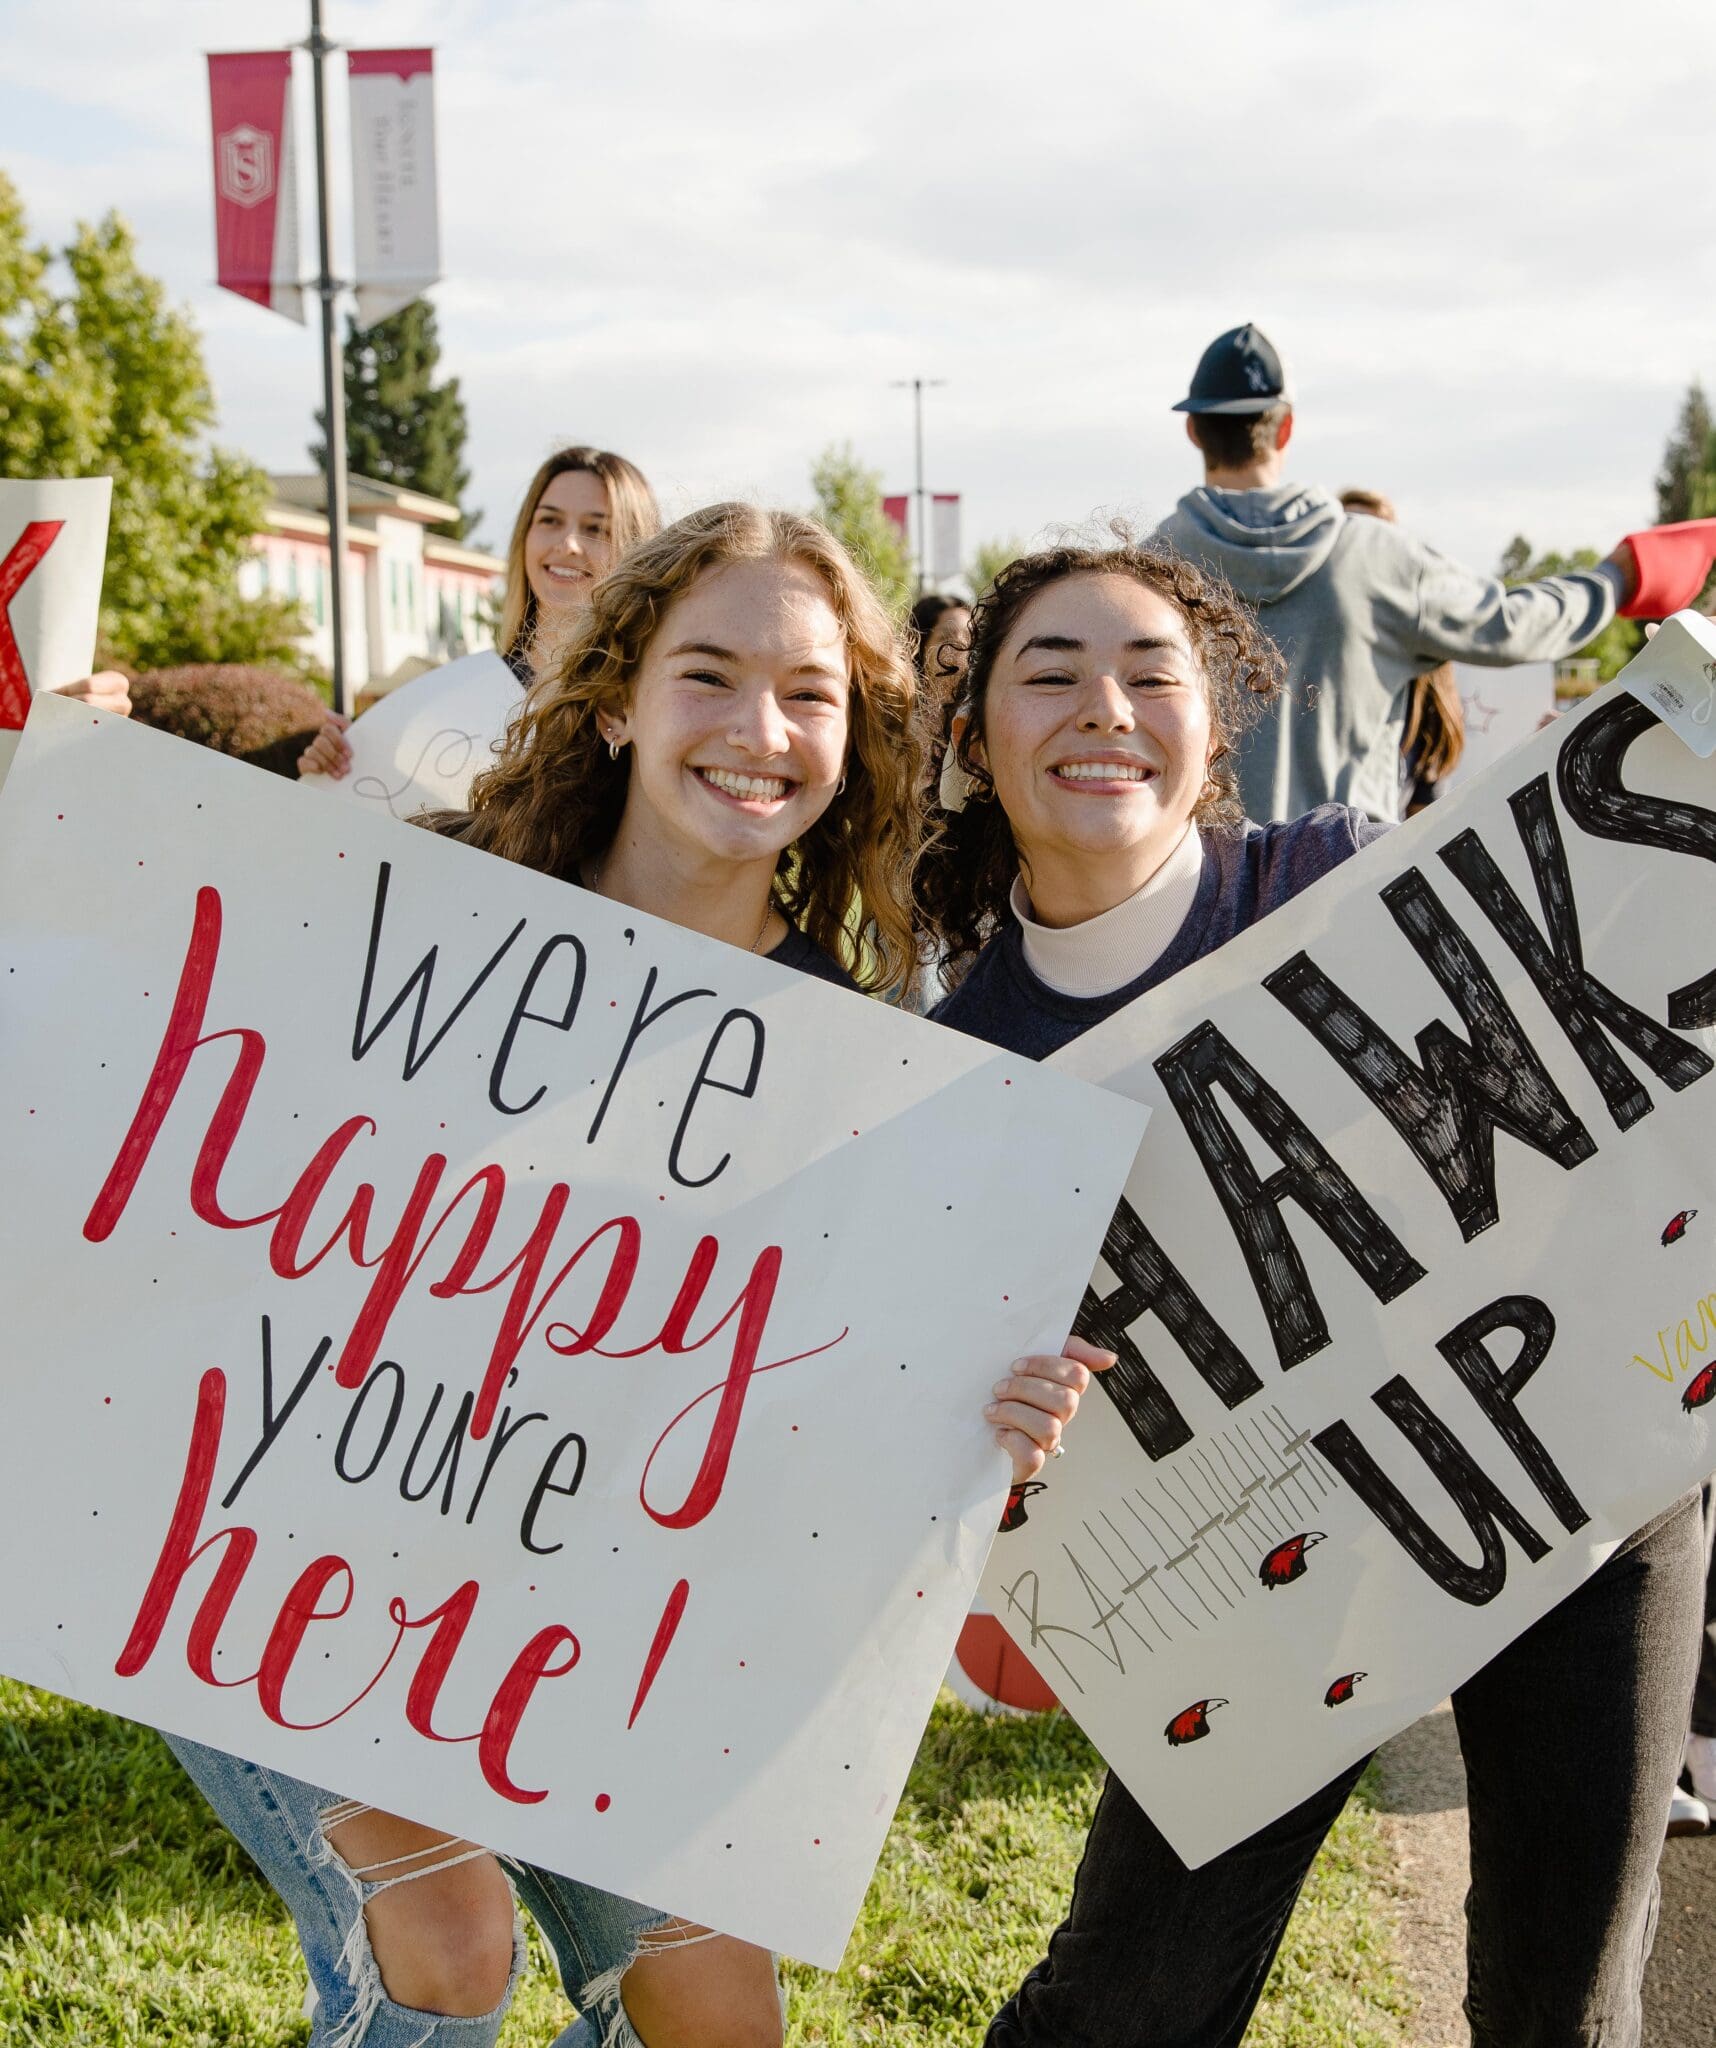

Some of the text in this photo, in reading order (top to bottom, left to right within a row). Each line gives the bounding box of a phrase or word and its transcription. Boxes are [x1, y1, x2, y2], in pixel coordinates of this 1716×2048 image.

[83, 885, 849, 1530] happy
[114, 1367, 690, 1813] here!
[1310, 1294, 1592, 1607] UP
